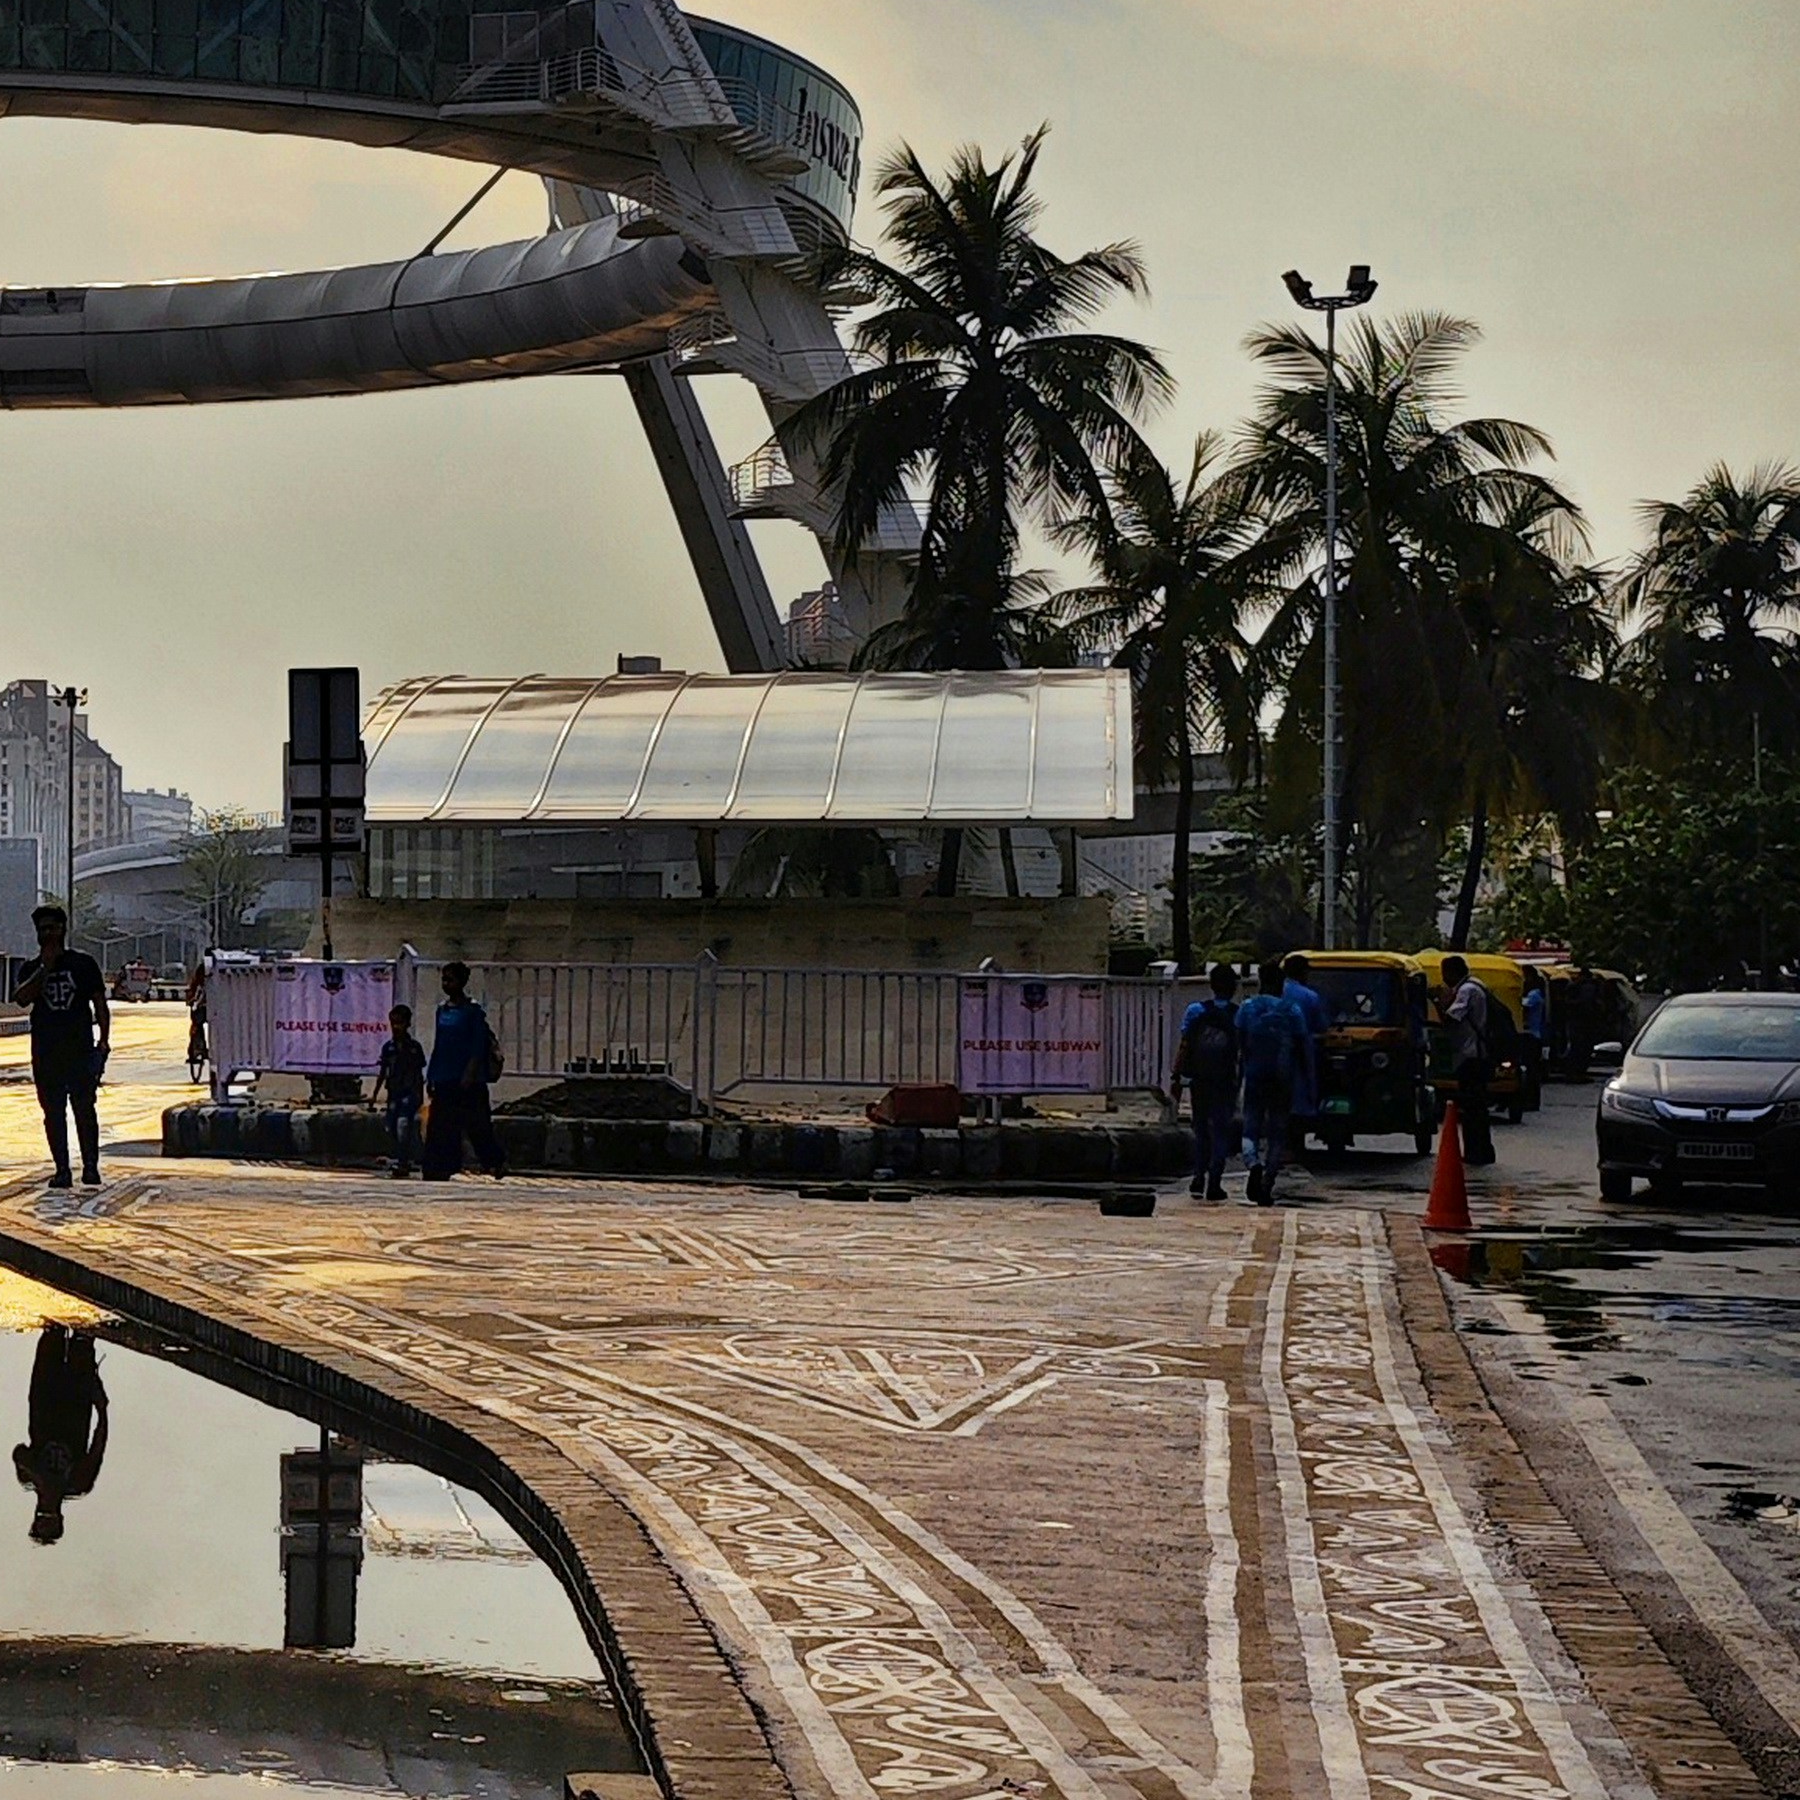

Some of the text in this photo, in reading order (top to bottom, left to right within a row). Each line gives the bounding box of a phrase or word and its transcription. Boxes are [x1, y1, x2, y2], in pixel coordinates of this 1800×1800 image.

[276, 1021, 316, 1032] PLEASE
[317, 1021, 339, 1032] USE
[964, 1040, 1101, 1051] PLEASE USE SUBWAY
